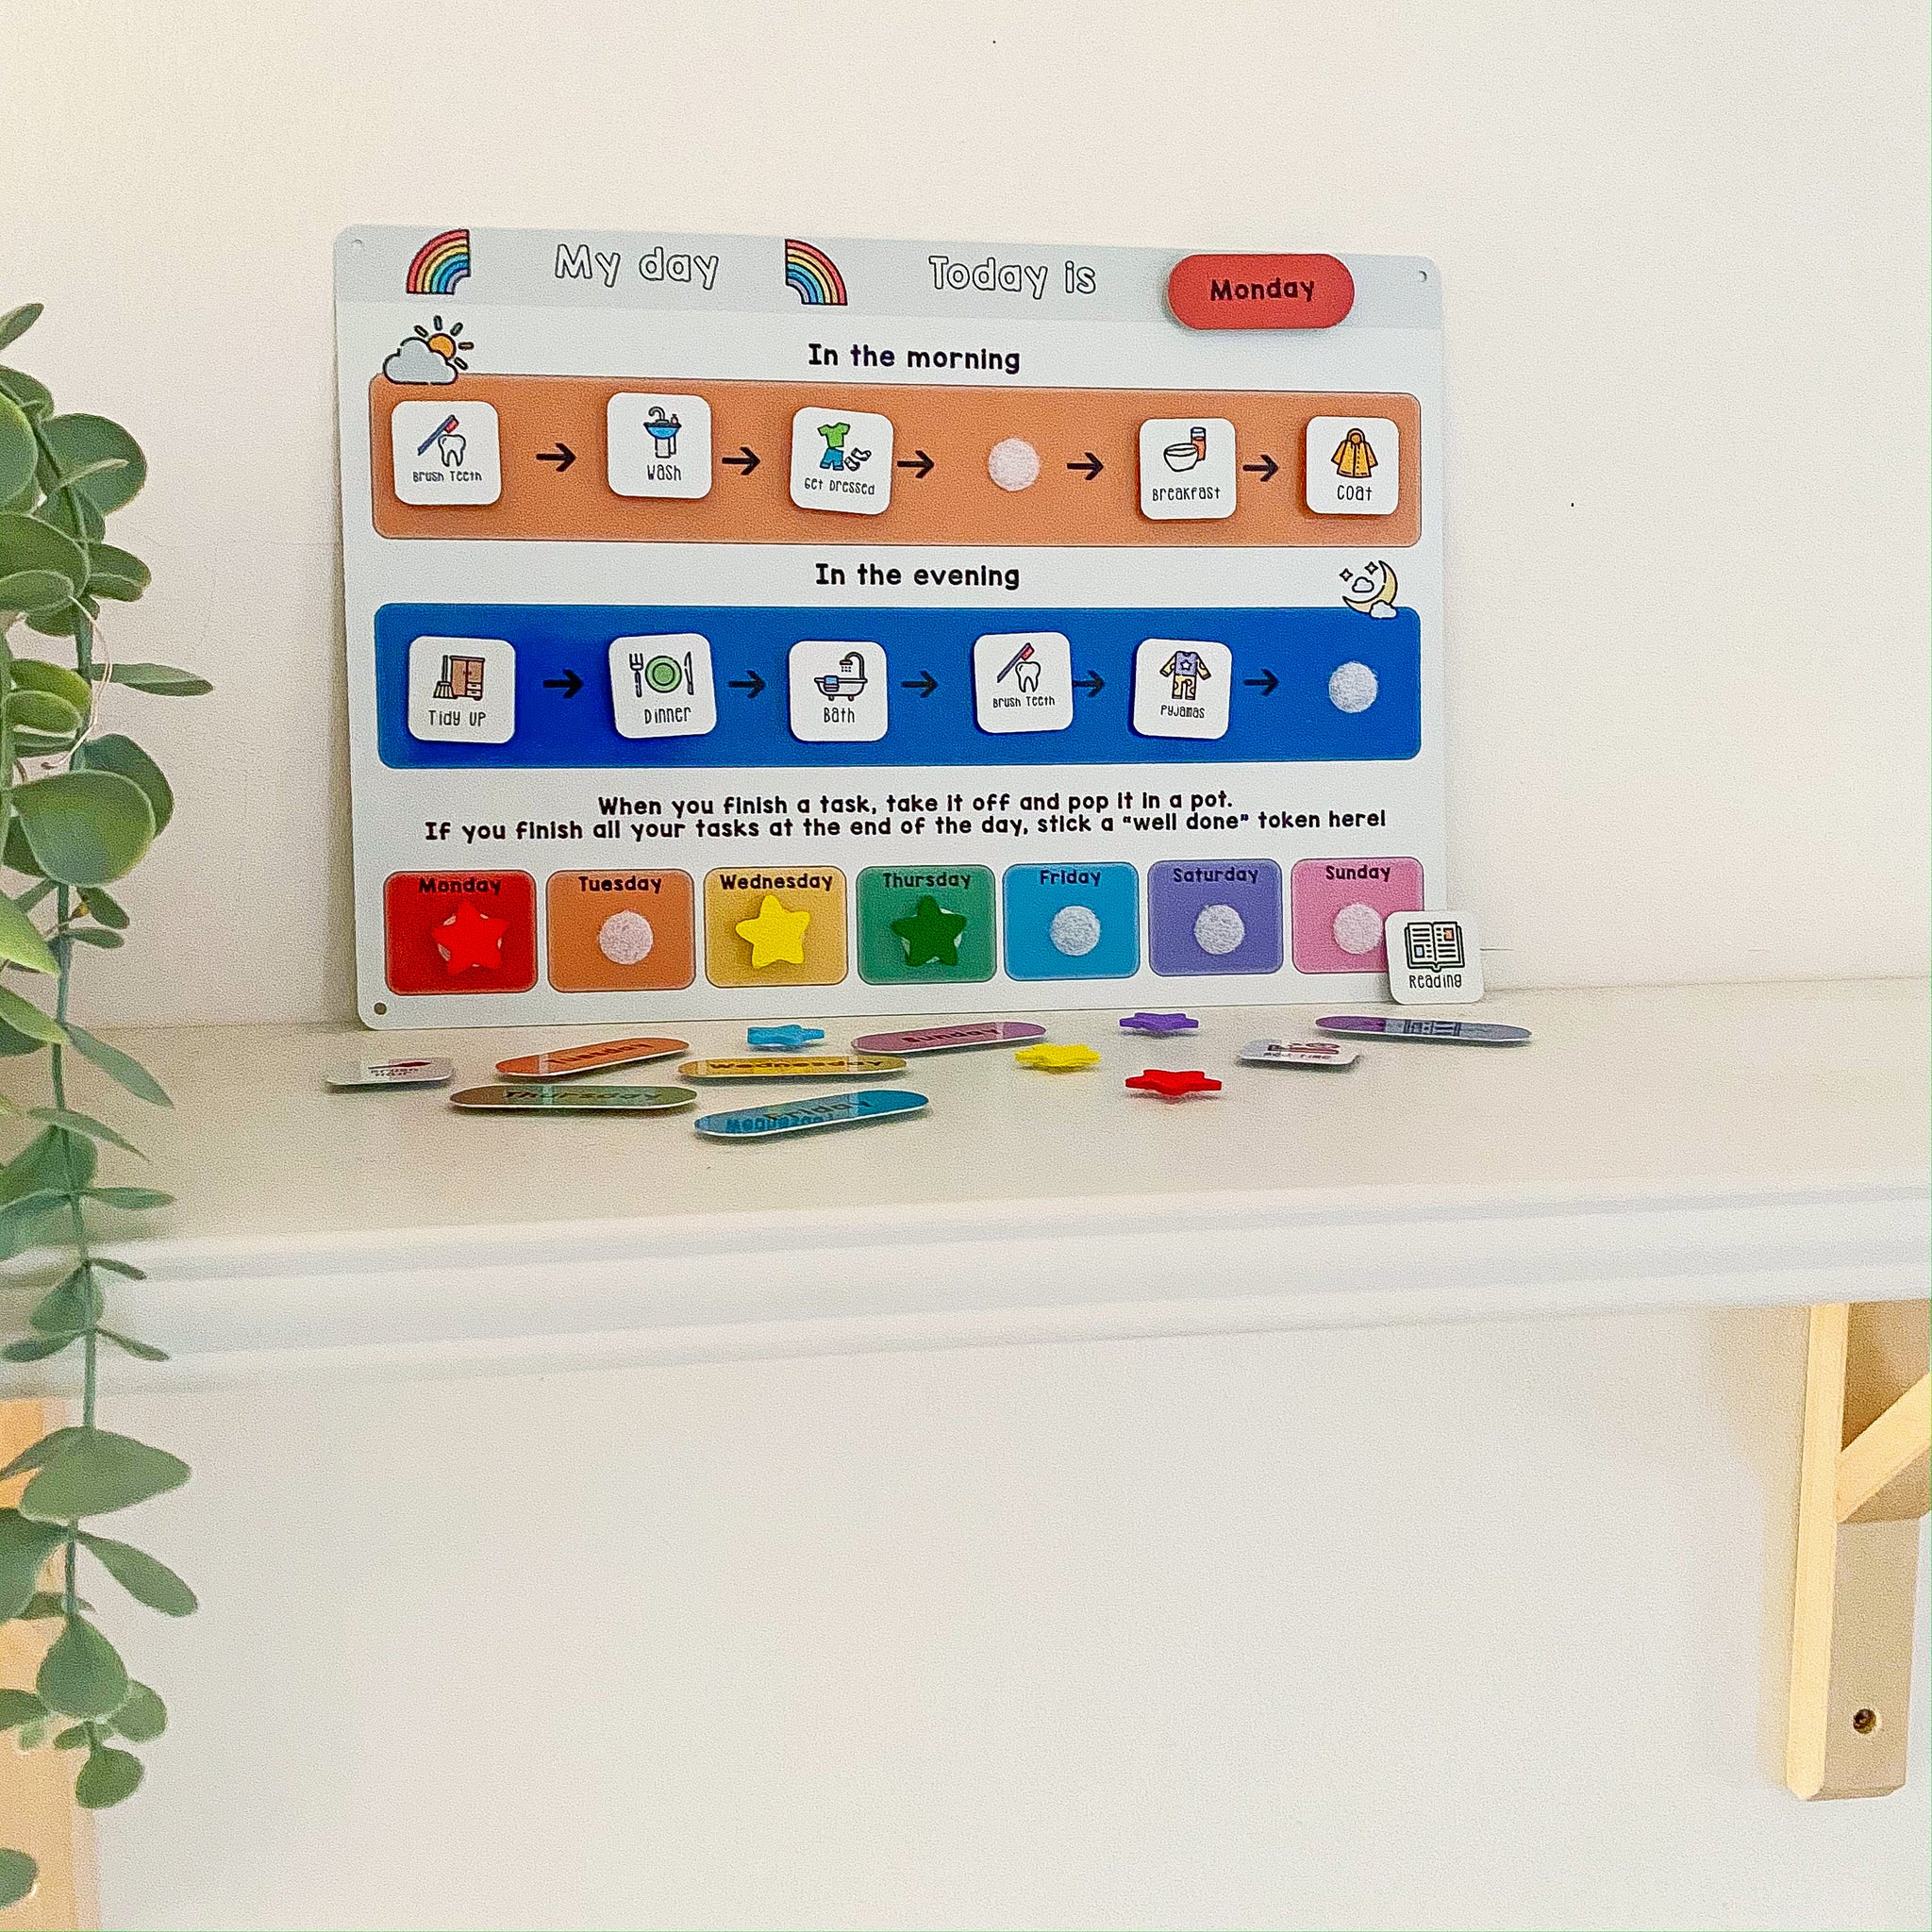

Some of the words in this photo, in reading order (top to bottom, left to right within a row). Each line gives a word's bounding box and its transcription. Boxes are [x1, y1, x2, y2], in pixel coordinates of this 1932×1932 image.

[554, 242, 622, 289] My
[638, 245, 720, 291] day
[927, 254, 1049, 301] Today
[1064, 259, 1097, 295] is
[1210, 277, 1315, 303] Monday
[808, 342, 839, 366] In
[850, 343, 895, 367] the
[907, 348, 1020, 375] morning
[412, 471, 445, 483] Brush
[449, 470, 483, 482] Teeth
[646, 463, 682, 481] Wash
[804, 476, 824, 491] Get
[828, 479, 875, 496] Dressed
[1152, 486, 1221, 502] Breakfast
[1336, 484, 1373, 502] Coat
[815, 562, 845, 585] In
[857, 563, 902, 586] the
[913, 564, 1020, 591] evening
[992, 697, 1022, 708] Brush
[1025, 695, 1056, 707] Teeth
[428, 709, 461, 726] Tidy
[643, 706, 691, 724] Dinner
[823, 707, 856, 724] Bath
[1159, 704, 1205, 719] Pyjamas
[598, 796, 662, 816] When
[671, 800, 714, 820] you
[723, 795, 788, 815] finish
[796, 798, 810, 814] a
[820, 794, 877, 815] task,
[886, 794, 939, 813] take
[947, 793, 963, 812] it
[972, 792, 1010, 811] off
[1019, 792, 1060, 811] and
[1068, 795, 1109, 814] pop
[1117, 791, 1133, 809] it
[1141, 791, 1160, 809] in
[1169, 793, 1182, 808] a
[1191, 790, 1233, 812] pot.
[425, 821, 451, 841] If
[461, 824, 506, 844] you
[515, 820, 583, 840] finish
[592, 820, 621, 839] all
[630, 823, 686, 842] your
[695, 819, 759, 838] tasks
[769, 818, 793, 837] at
[803, 818, 841, 837] the
[850, 817, 891, 836] end
[900, 816, 925, 835] of
[935, 816, 972, 835] the
[981, 815, 1028, 837] day,
[1037, 814, 1091, 833] stick
[1101, 817, 1114, 832] a
[1257, 810, 1321, 829] token
[720, 874, 833, 891] Wednesday
[883, 872, 971, 890] Thursday
[1040, 870, 1101, 887] Friday
[1173, 867, 1258, 885] Saturday
[1325, 864, 1391, 883] Sunday
[419, 877, 501, 895] Monday
[578, 875, 661, 894] Tuesday
[1408, 974, 1462, 989] Reading
[901, 1028, 1001, 1042] Sunday
[545, 1043, 654, 1064] Tuesday
[709, 1060, 883, 1070] Wednesday
[504, 1091, 663, 1101] Thursday
[762, 1100, 874, 1121] Friday
